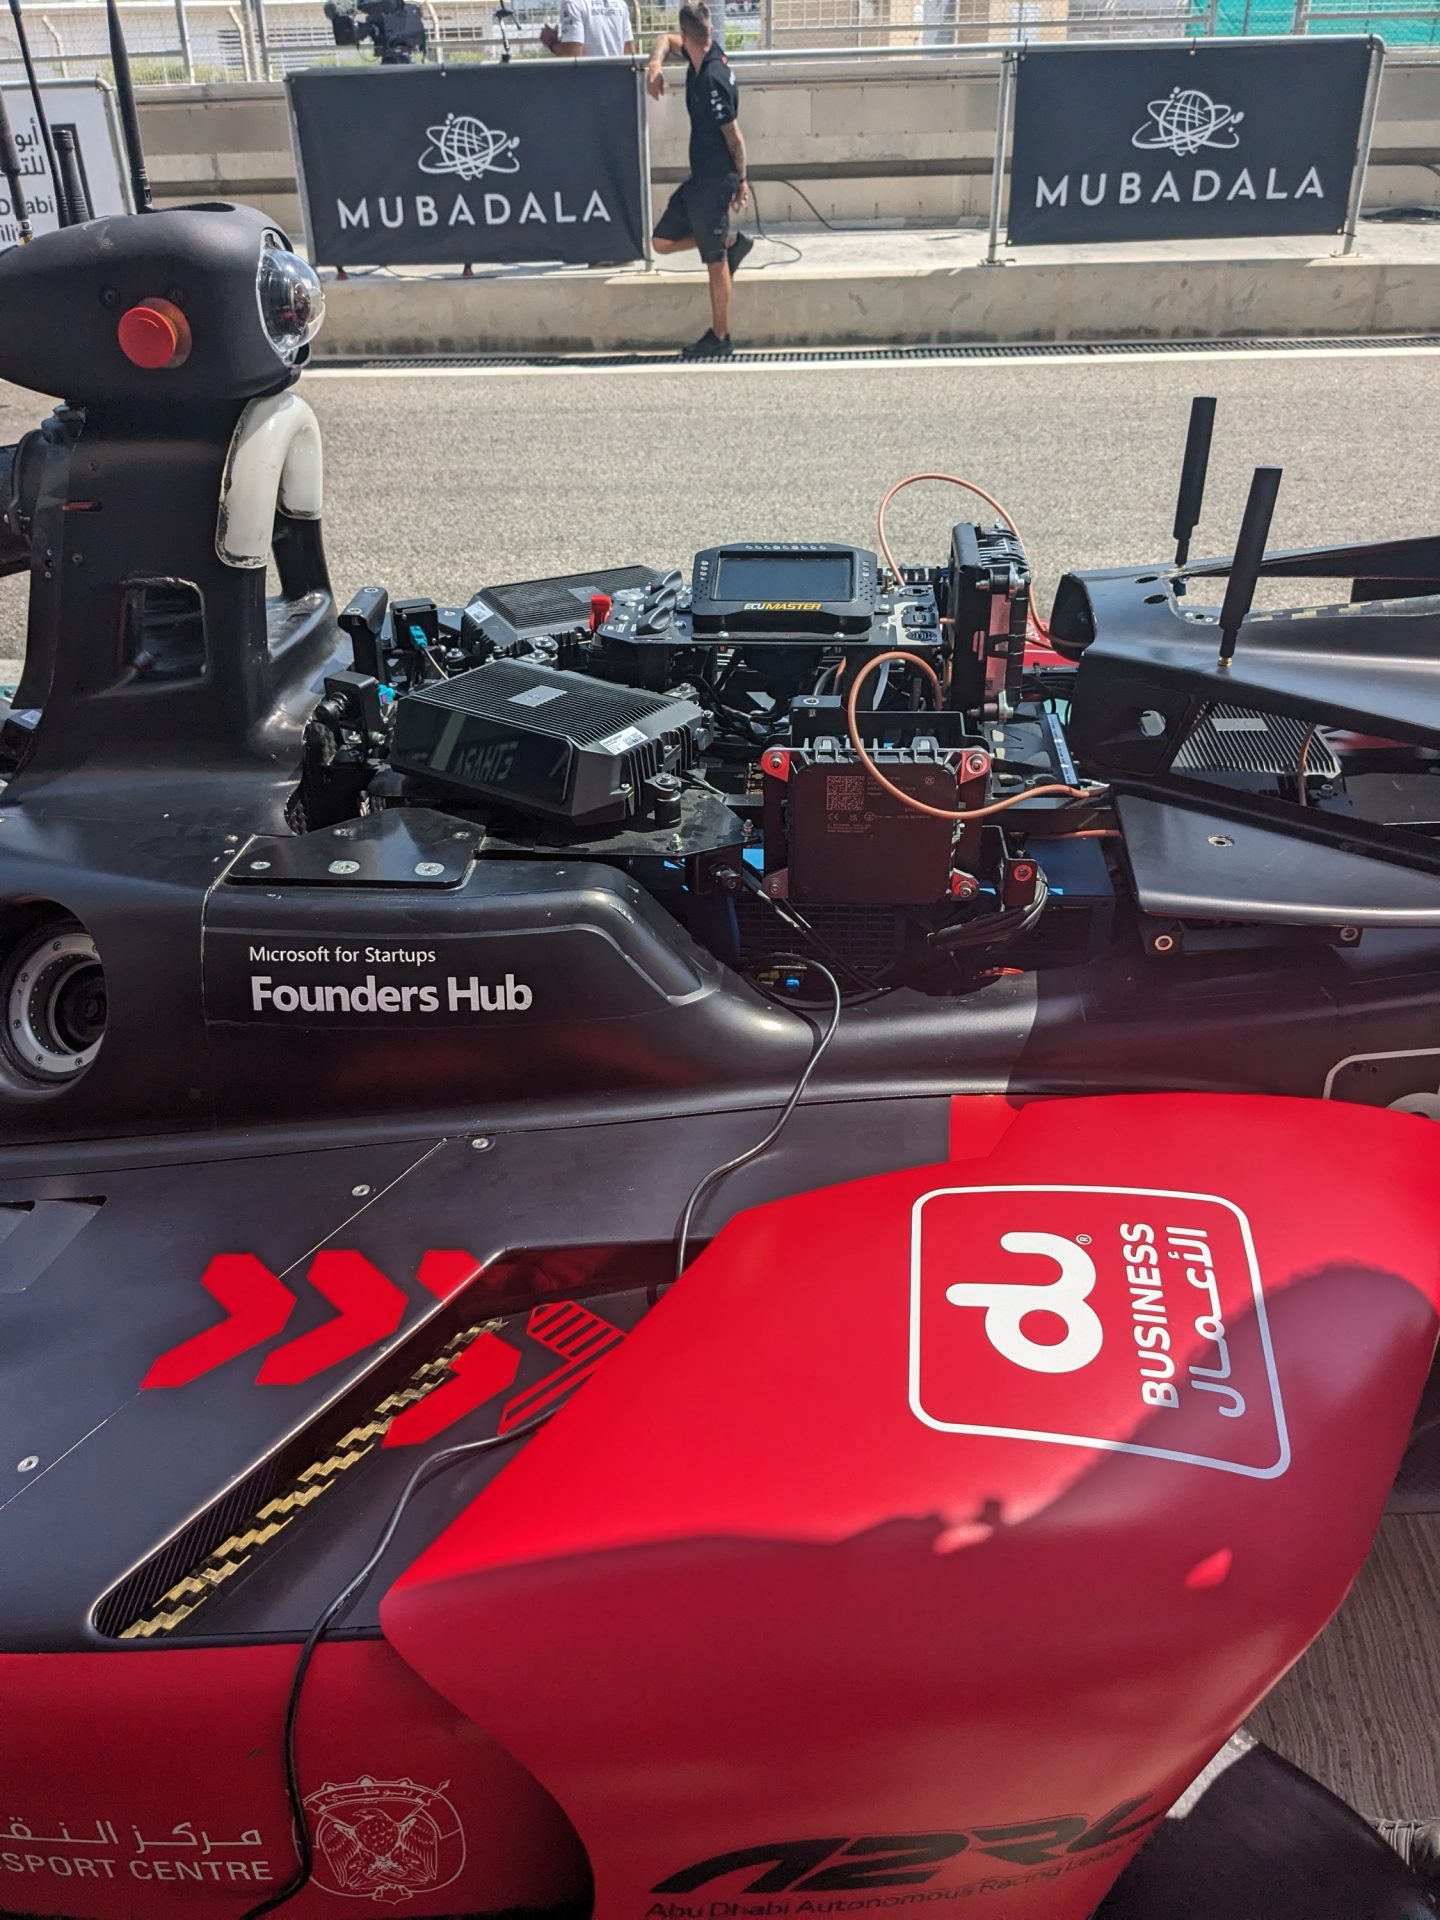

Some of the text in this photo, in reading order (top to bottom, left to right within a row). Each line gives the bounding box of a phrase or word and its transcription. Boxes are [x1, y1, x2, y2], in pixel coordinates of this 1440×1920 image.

[0, 195, 55, 216] Dabi
[1035, 166, 1324, 208] MUBADALA
[336, 190, 611, 229] MUBADALA
[744, 602, 822, 612] ECUMASTER
[249, 946, 436, 966] Microsoft for Startups
[251, 974, 533, 1012] Founders Hub
[945, 1231, 1104, 1374] du
[1120, 1222, 1180, 1408] BUSINESS
[0, 1816, 262, 1855] مركز النق
[0, 1852, 275, 1881] SPORT CENTRE
[645, 1901, 704, 1918] Abu
[710, 1901, 789, 1916] Dhabi
[795, 1881, 973, 1915] Autonomous
[979, 1864, 1062, 1894] Racing
